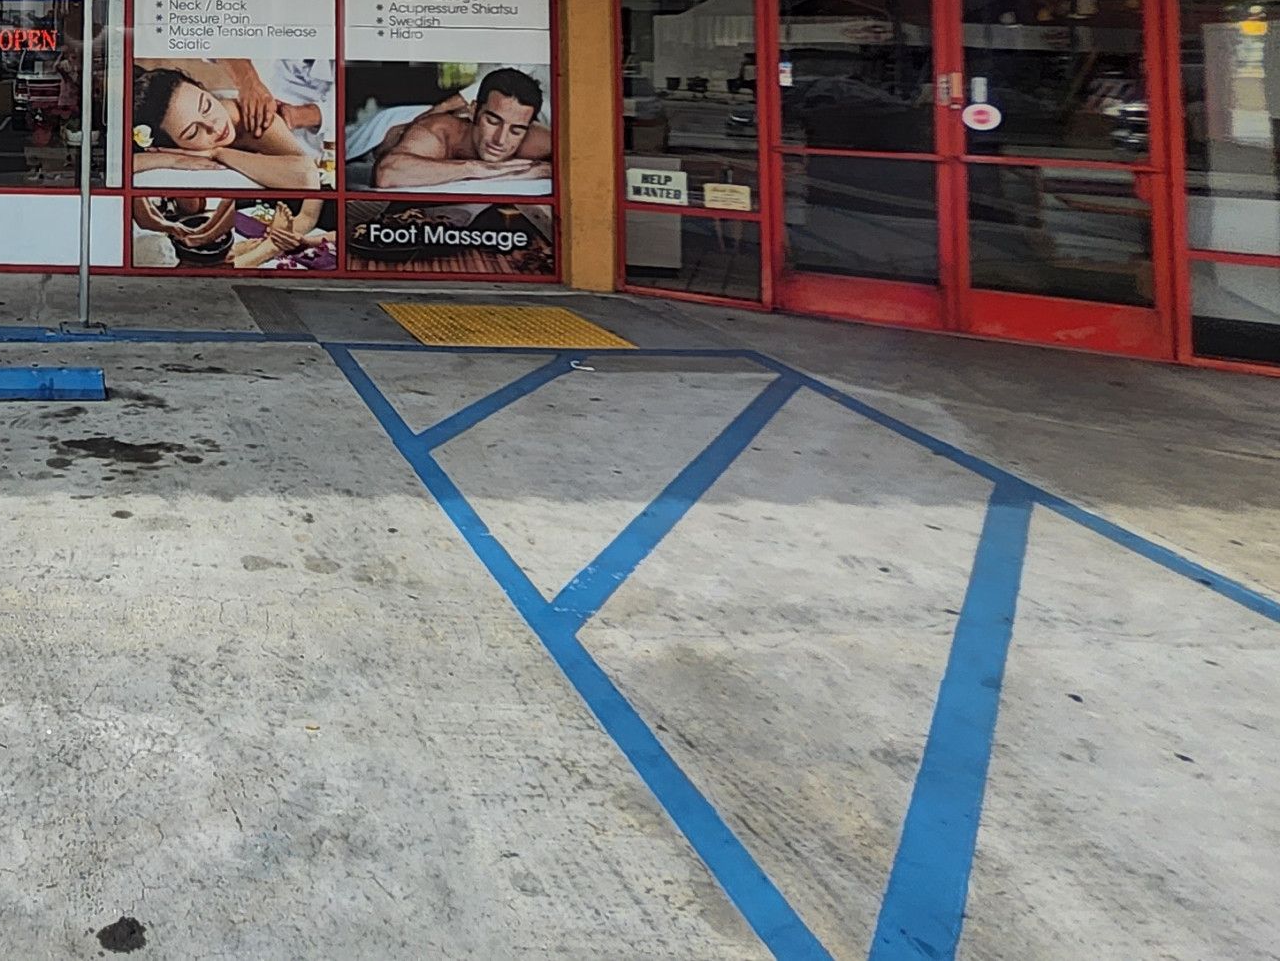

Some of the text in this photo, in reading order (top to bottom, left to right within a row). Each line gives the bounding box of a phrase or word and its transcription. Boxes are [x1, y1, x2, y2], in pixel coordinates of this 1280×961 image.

[169, 0, 201, 11] Neck
[216, 0, 247, 11] Back
[389, 3, 518, 15] Acupressure Shiatsu
[169, 13, 250, 24] Pressure Pain
[389, 16, 440, 27] Swedish
[169, 26, 317, 37] Muscle Tension Release
[390, 28, 423, 39] Hidro
[169, 38, 211, 50] Sciatic
[641, 174, 672, 185] HELP
[632, 186, 681, 200] WANTED
[370, 224, 528, 251] Foot Massage
